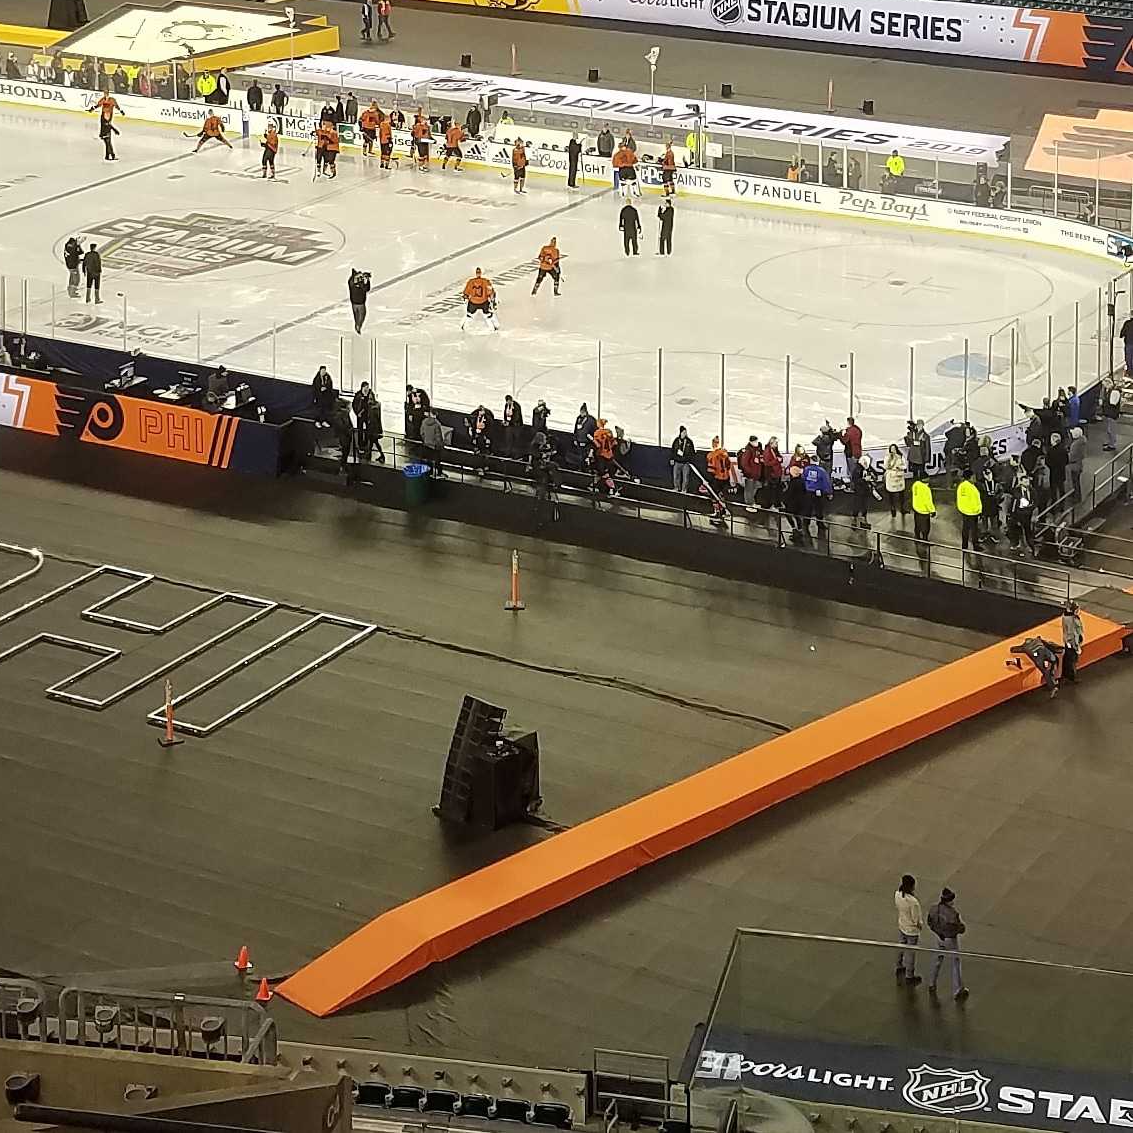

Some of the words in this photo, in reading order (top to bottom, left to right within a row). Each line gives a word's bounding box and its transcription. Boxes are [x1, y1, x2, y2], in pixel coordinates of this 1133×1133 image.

[746, 0, 861, 34] STADIUM
[869, 10, 962, 42] SERIES
[0, 83, 67, 103] HONDA
[172, 106, 231, 125] MassMal
[491, 87, 704, 124] STADIUM
[707, 114, 899, 145] SERIES
[905, 137, 987, 155] 2019
[753, 183, 822, 204] FANDUEL
[880, 196, 929, 221] Boys
[103, 220, 318, 264] STADIUM
[122, 238, 236, 264] SERIES
[138, 407, 204, 454] PHI
[807, 1068, 890, 1092] LIGHT
[920, 1079, 974, 1104] NHL
